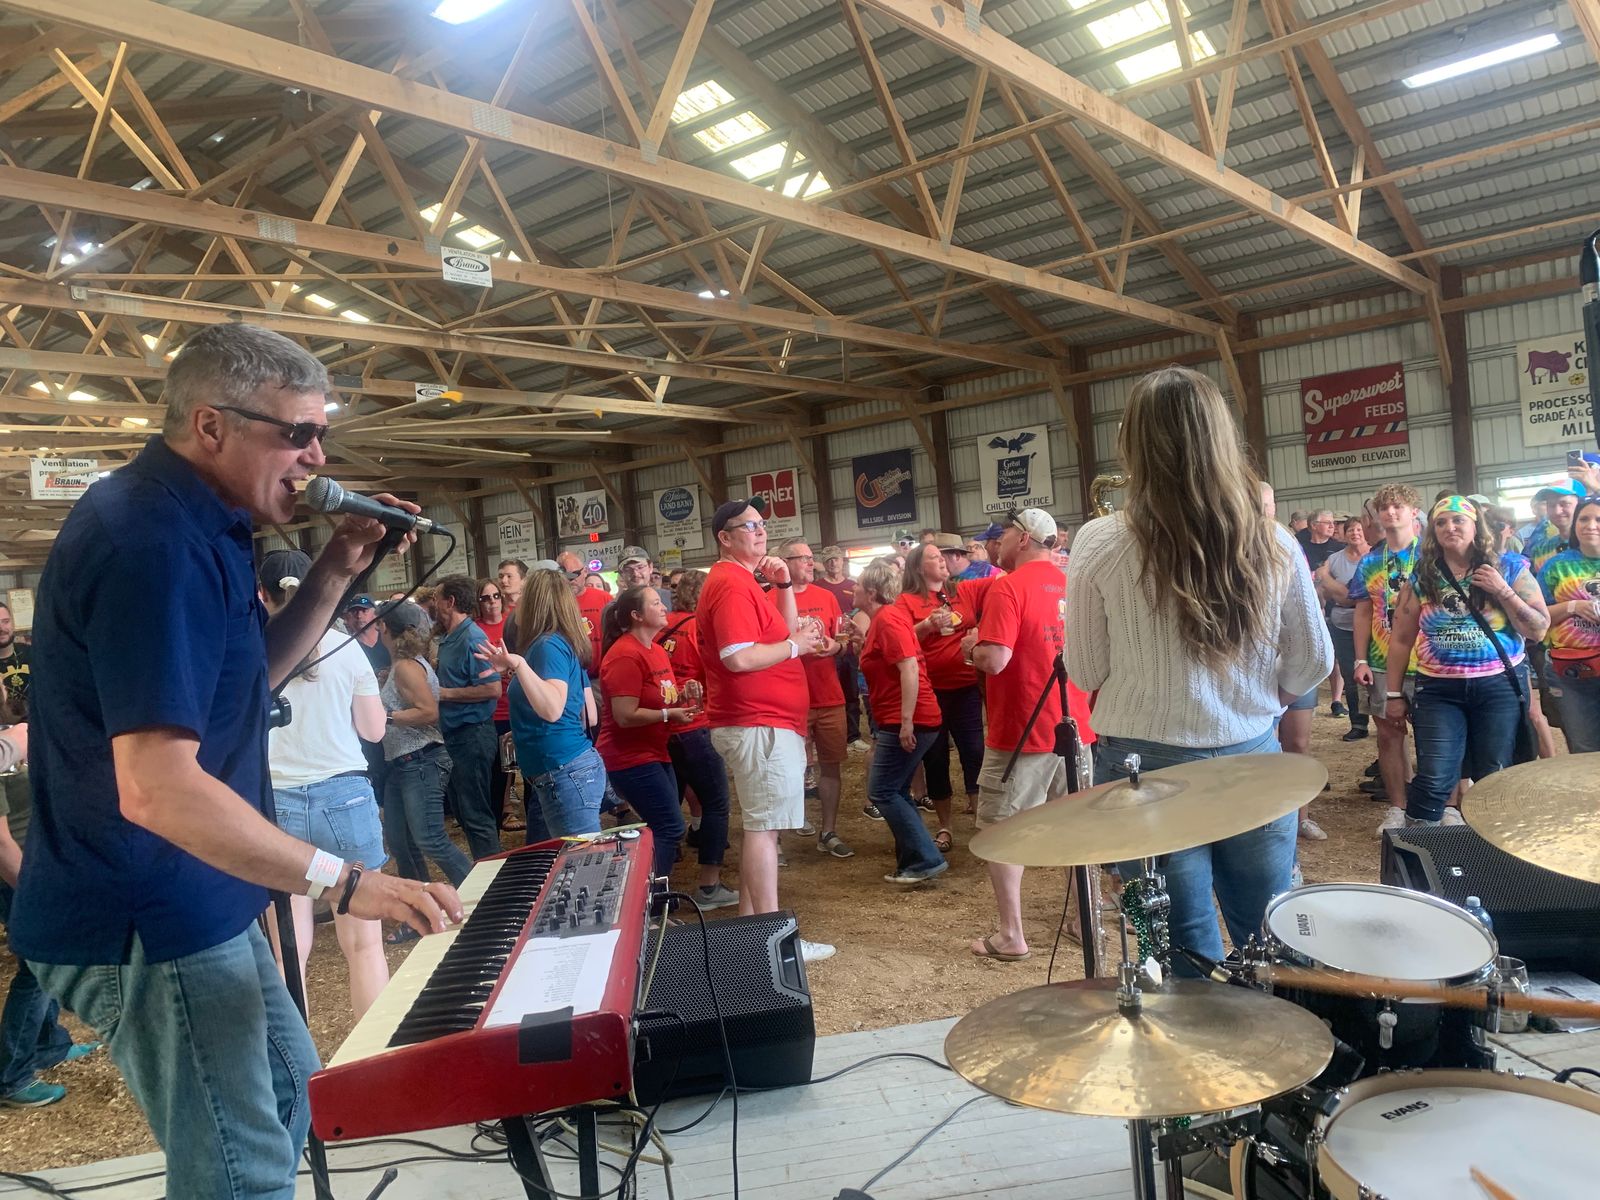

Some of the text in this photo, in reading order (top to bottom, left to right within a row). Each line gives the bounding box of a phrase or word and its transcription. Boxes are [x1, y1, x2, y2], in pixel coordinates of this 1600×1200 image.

[453, 257, 480, 270] Braun
[1304, 371, 1403, 425] Supersweet
[1365, 401, 1405, 418] FEEDS
[1529, 411, 1566, 424] GRADE
[41, 460, 89, 468] Ventilation
[1311, 448, 1407, 468] SHERWOOD ELEVATOR
[1003, 460, 1020, 470] Great
[1001, 468, 1025, 477] Midwest
[1000, 477, 1025, 486] Savings
[661, 500, 693, 511] LAND BANK
[986, 496, 1050, 511] CHILTON OFFICE
[584, 504, 602, 525] 40
[862, 512, 912, 525] HILLSIDE DIVISION
[499, 524, 522, 540] HEIN
[588, 545, 622, 557] COMPEER
[1296, 913, 1311, 937] EVANS
[1380, 1100, 1429, 1120] EVANS
